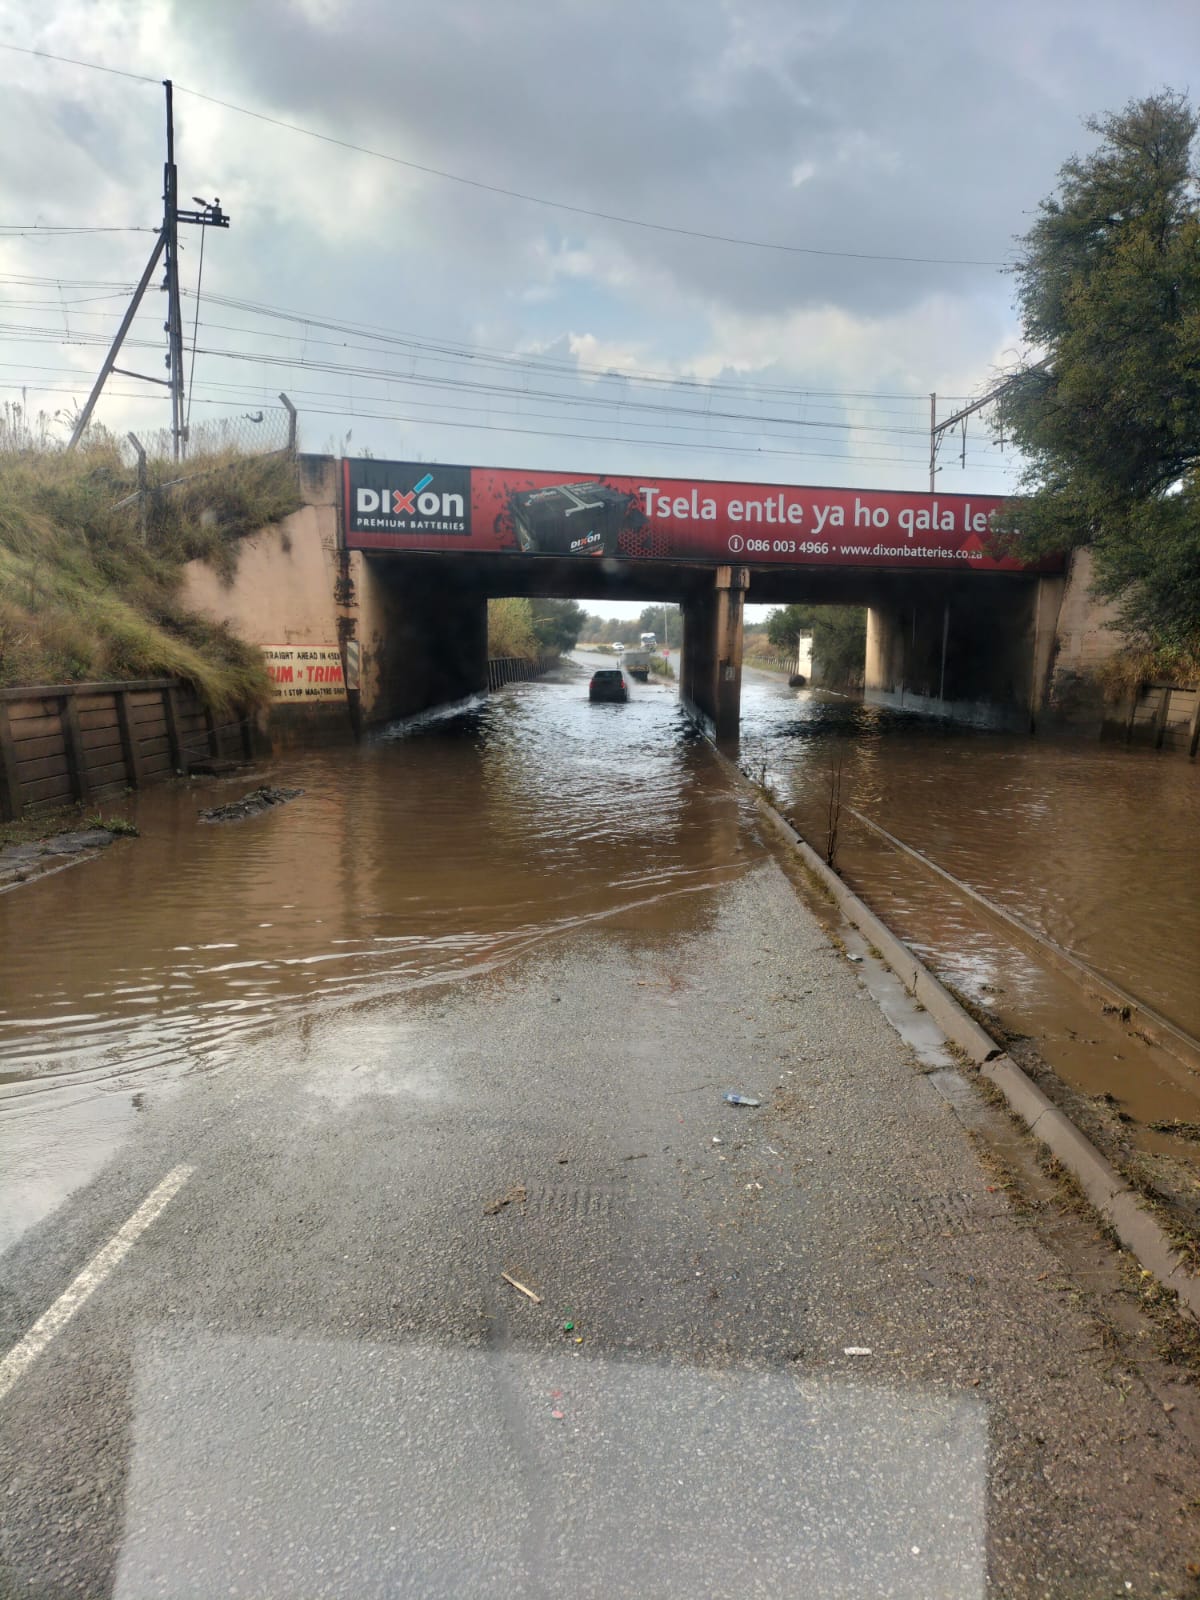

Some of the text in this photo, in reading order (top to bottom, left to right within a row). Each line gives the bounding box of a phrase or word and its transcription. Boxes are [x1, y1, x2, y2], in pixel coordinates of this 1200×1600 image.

[639, 487, 717, 519] Tsela
[727, 493, 804, 524] entle
[811, 505, 845, 534] ya
[854, 497, 889, 528] ho
[898, 501, 955, 537] qala
[357, 518, 465, 531] PREMIUM BATTERIES
[746, 538, 983, 559] 086 003 4966 www.dixonbatteries.co.za
[264, 651, 293, 660] TRAIGHT
[298, 651, 318, 660] AHEAD
[306, 666, 343, 682] TRIM
